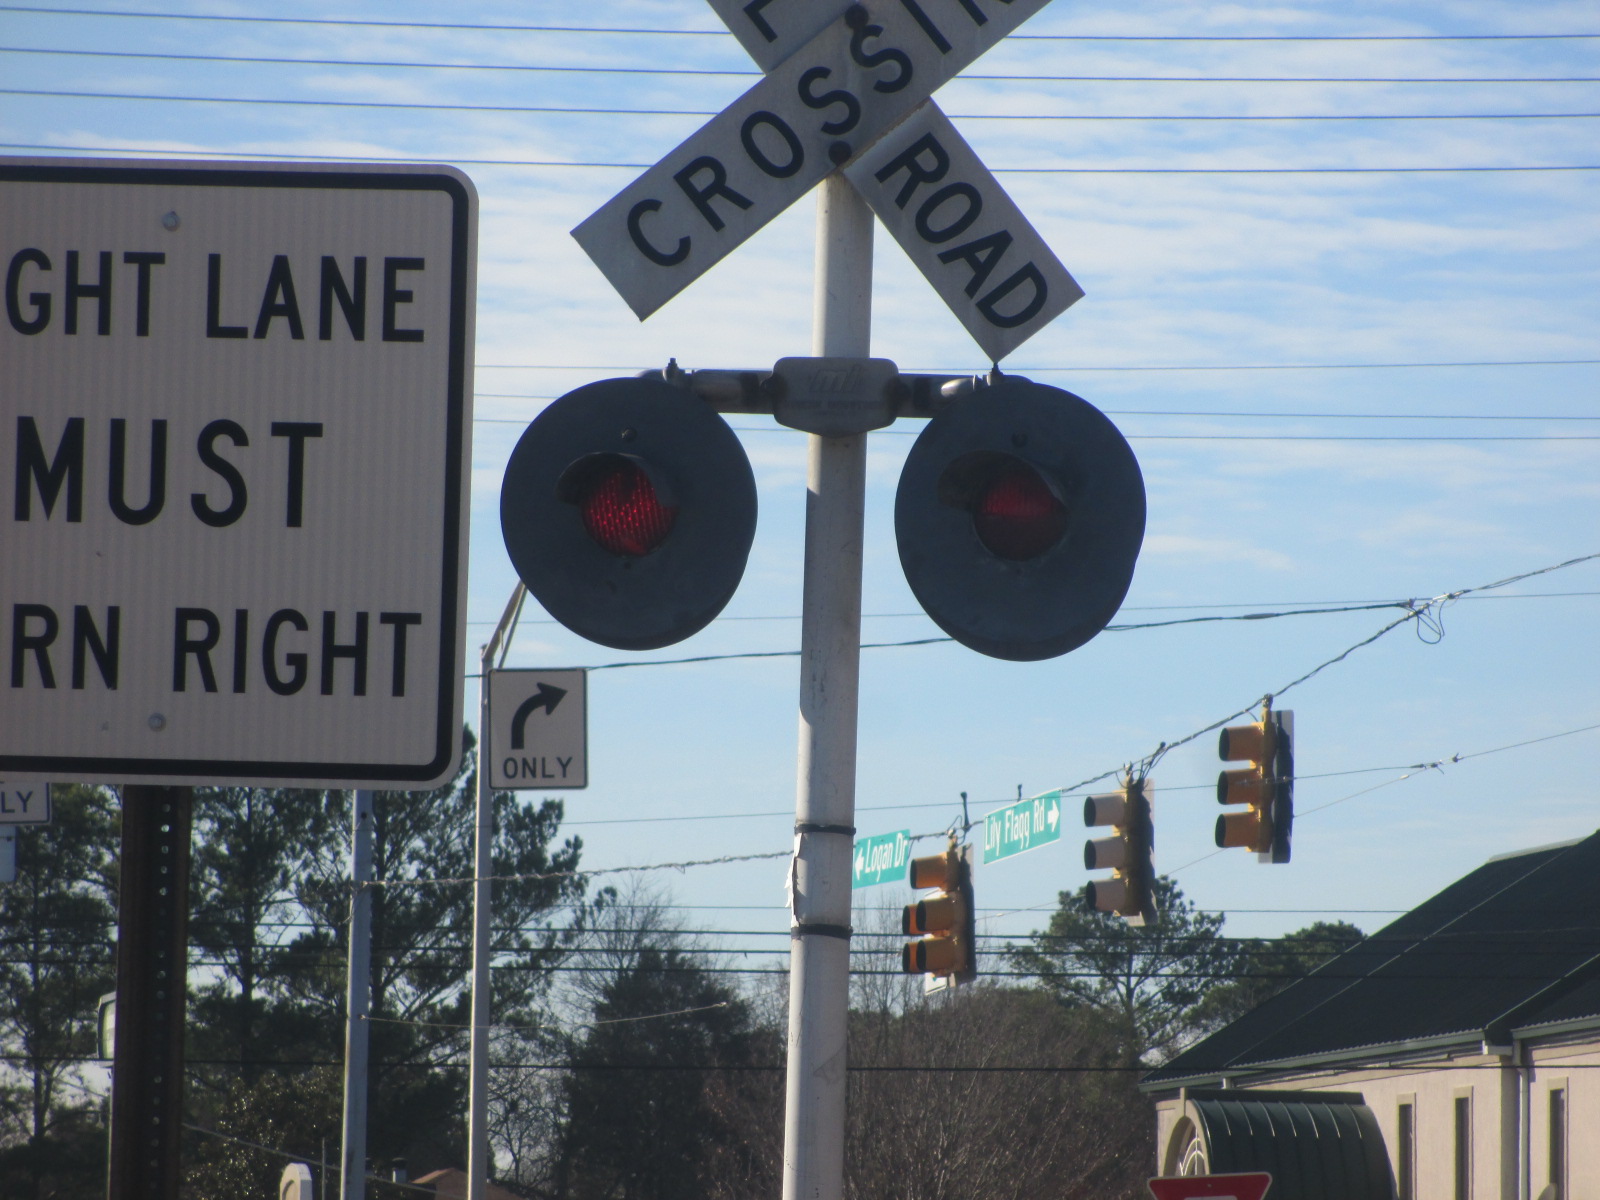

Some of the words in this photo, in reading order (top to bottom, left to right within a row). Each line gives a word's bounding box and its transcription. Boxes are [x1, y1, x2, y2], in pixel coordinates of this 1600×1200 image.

[874, 132, 1048, 329] ROAD
[5, 248, 166, 337] GHT
[206, 253, 425, 342] LANE
[14, 415, 323, 528] MUST
[10, 603, 120, 691] RN
[172, 607, 422, 697] RIGHT
[503, 756, 573, 779] ONLY
[865, 839, 892, 882] Logan
[894, 832, 909, 868] Dr
[984, 816, 1001, 856] Lily
[1005, 808, 1030, 850] Flagg
[1034, 798, 1045, 834] Rd
